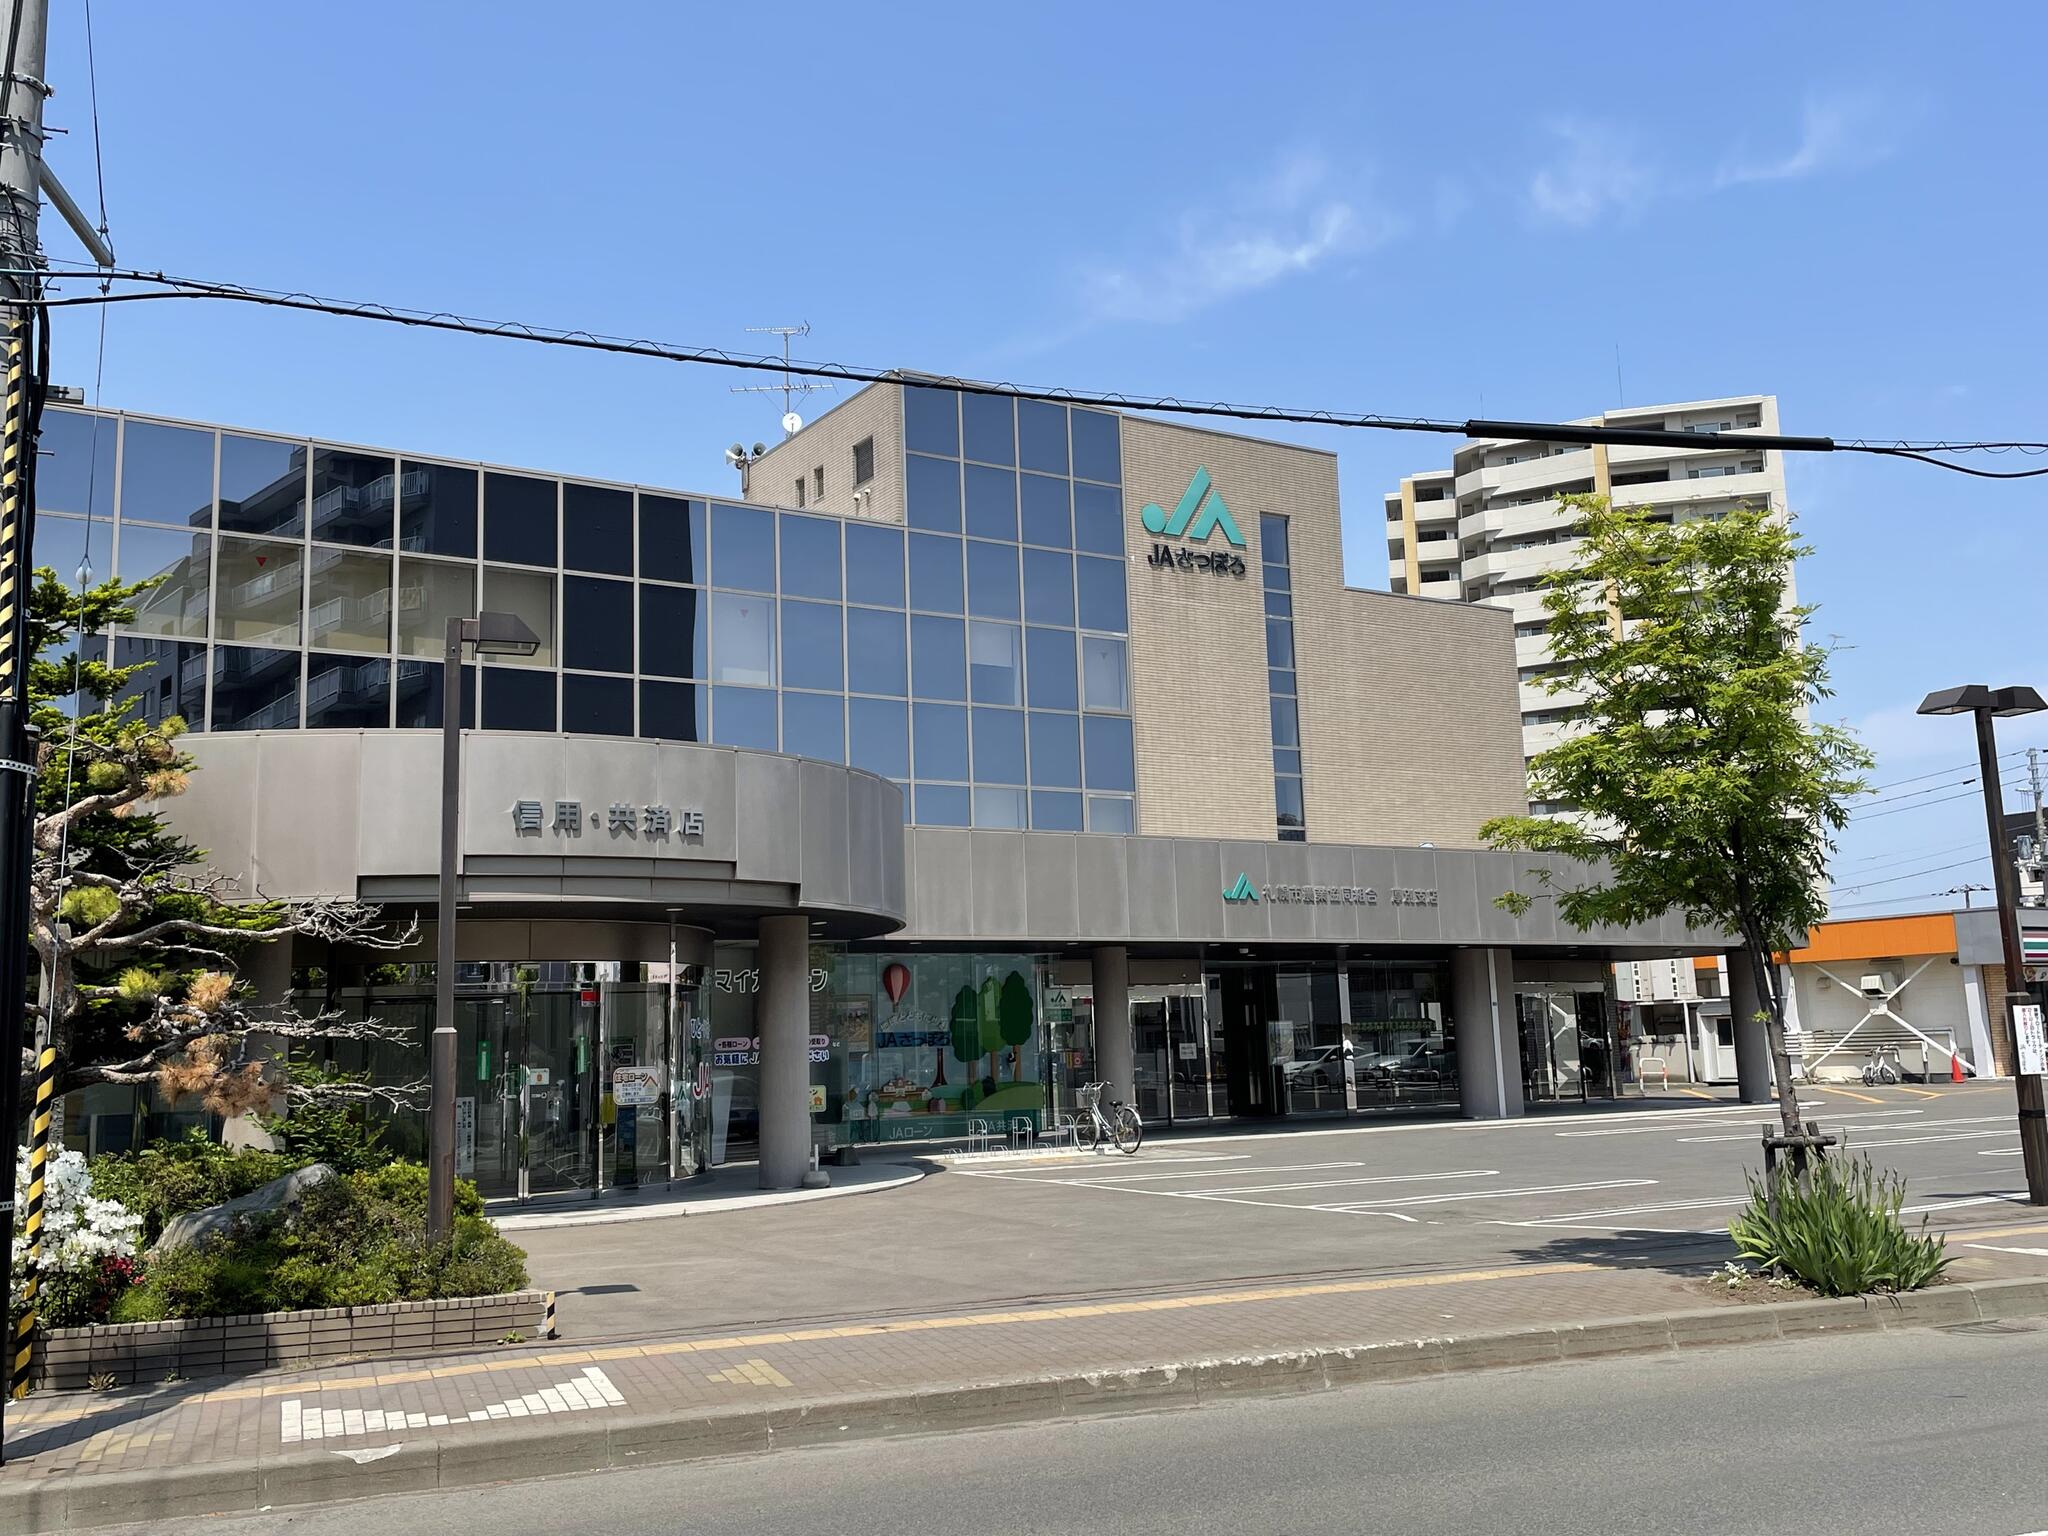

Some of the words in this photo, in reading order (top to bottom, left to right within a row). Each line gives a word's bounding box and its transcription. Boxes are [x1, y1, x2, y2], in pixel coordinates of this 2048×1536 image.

[512, 799, 706, 837] 信用・共済店
[889, 1125, 933, 1140] JAローン
